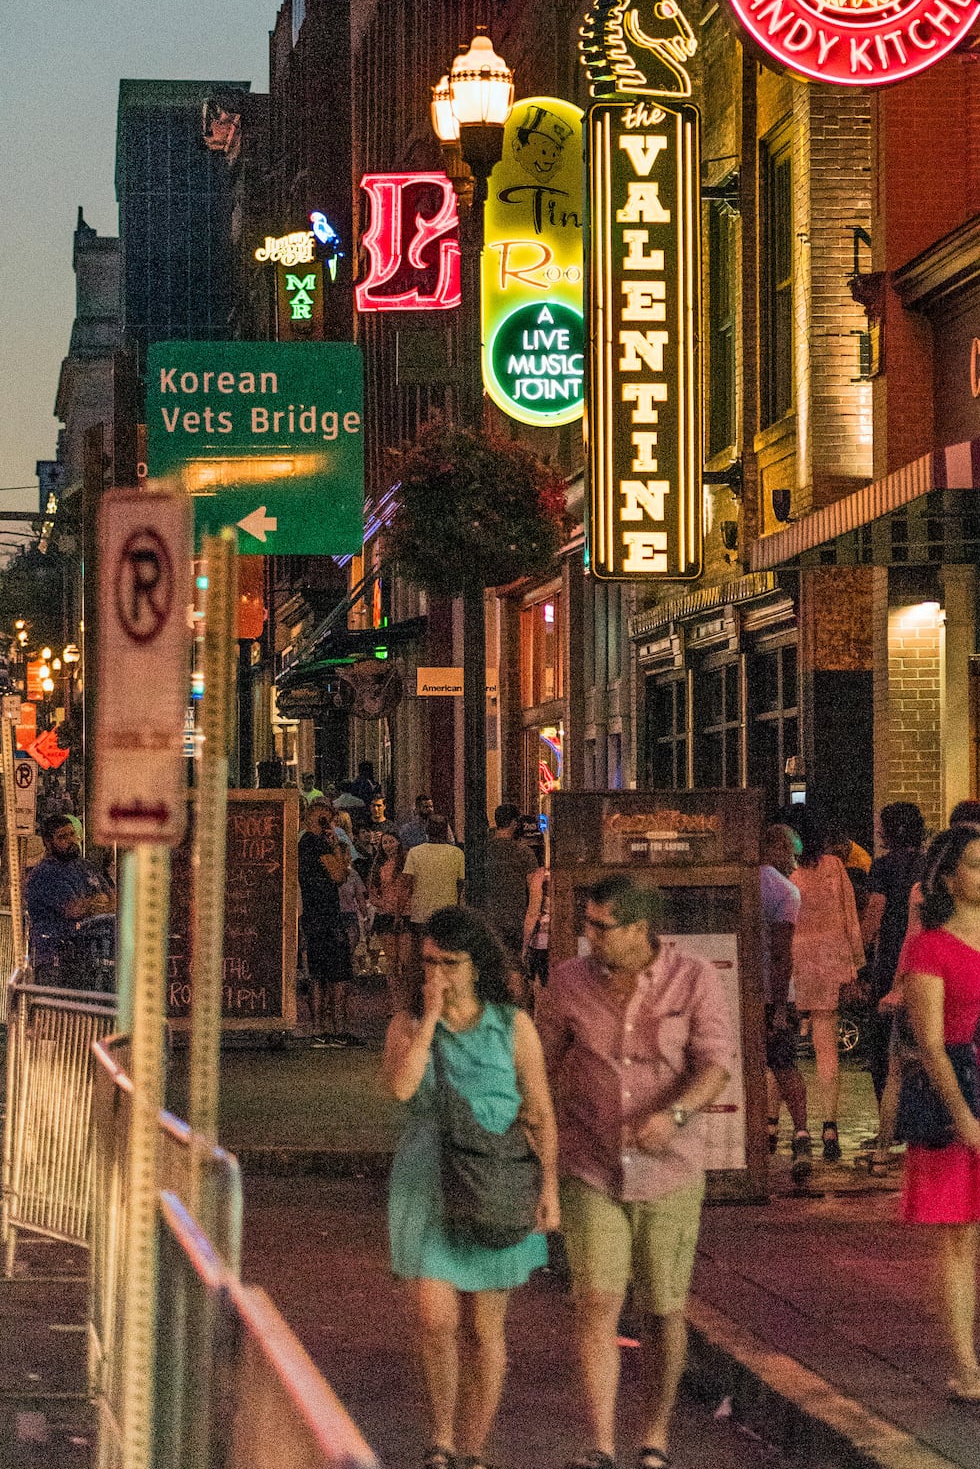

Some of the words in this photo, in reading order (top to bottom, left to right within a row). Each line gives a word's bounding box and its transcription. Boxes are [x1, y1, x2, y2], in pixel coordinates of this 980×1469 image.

[621, 101, 666, 131] the
[497, 185, 584, 235] Tin
[536, 304, 555, 325] A
[522, 329, 570, 351] LIVE
[507, 353, 585, 376] MUSIC
[615, 134, 671, 574] VALENTINE
[159, 367, 279, 394] Korean
[512, 378, 583, 401] JOINT
[160, 406, 233, 434] Vets
[250, 404, 362, 441] Bridge
[422, 684, 463, 693] American
